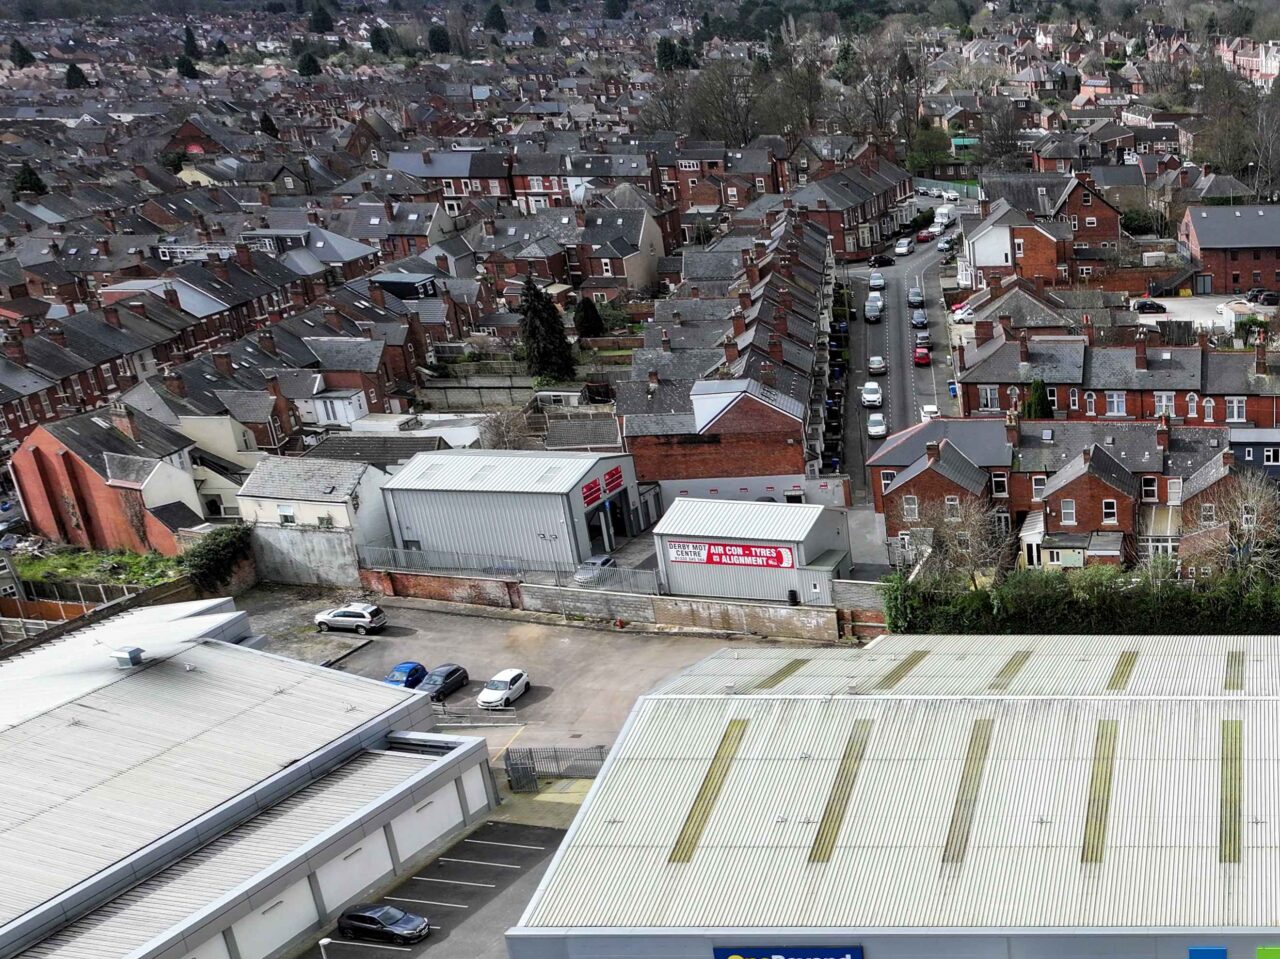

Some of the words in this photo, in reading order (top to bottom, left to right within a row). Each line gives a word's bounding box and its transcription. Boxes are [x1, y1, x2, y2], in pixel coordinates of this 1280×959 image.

[669, 543, 690, 551] DERBY
[710, 545, 724, 554] AIR
[727, 546, 743, 555] CON
[751, 547, 777, 557] TYRES
[676, 549, 702, 557] CENTRE
[722, 555, 767, 565] ALIGNMENT
